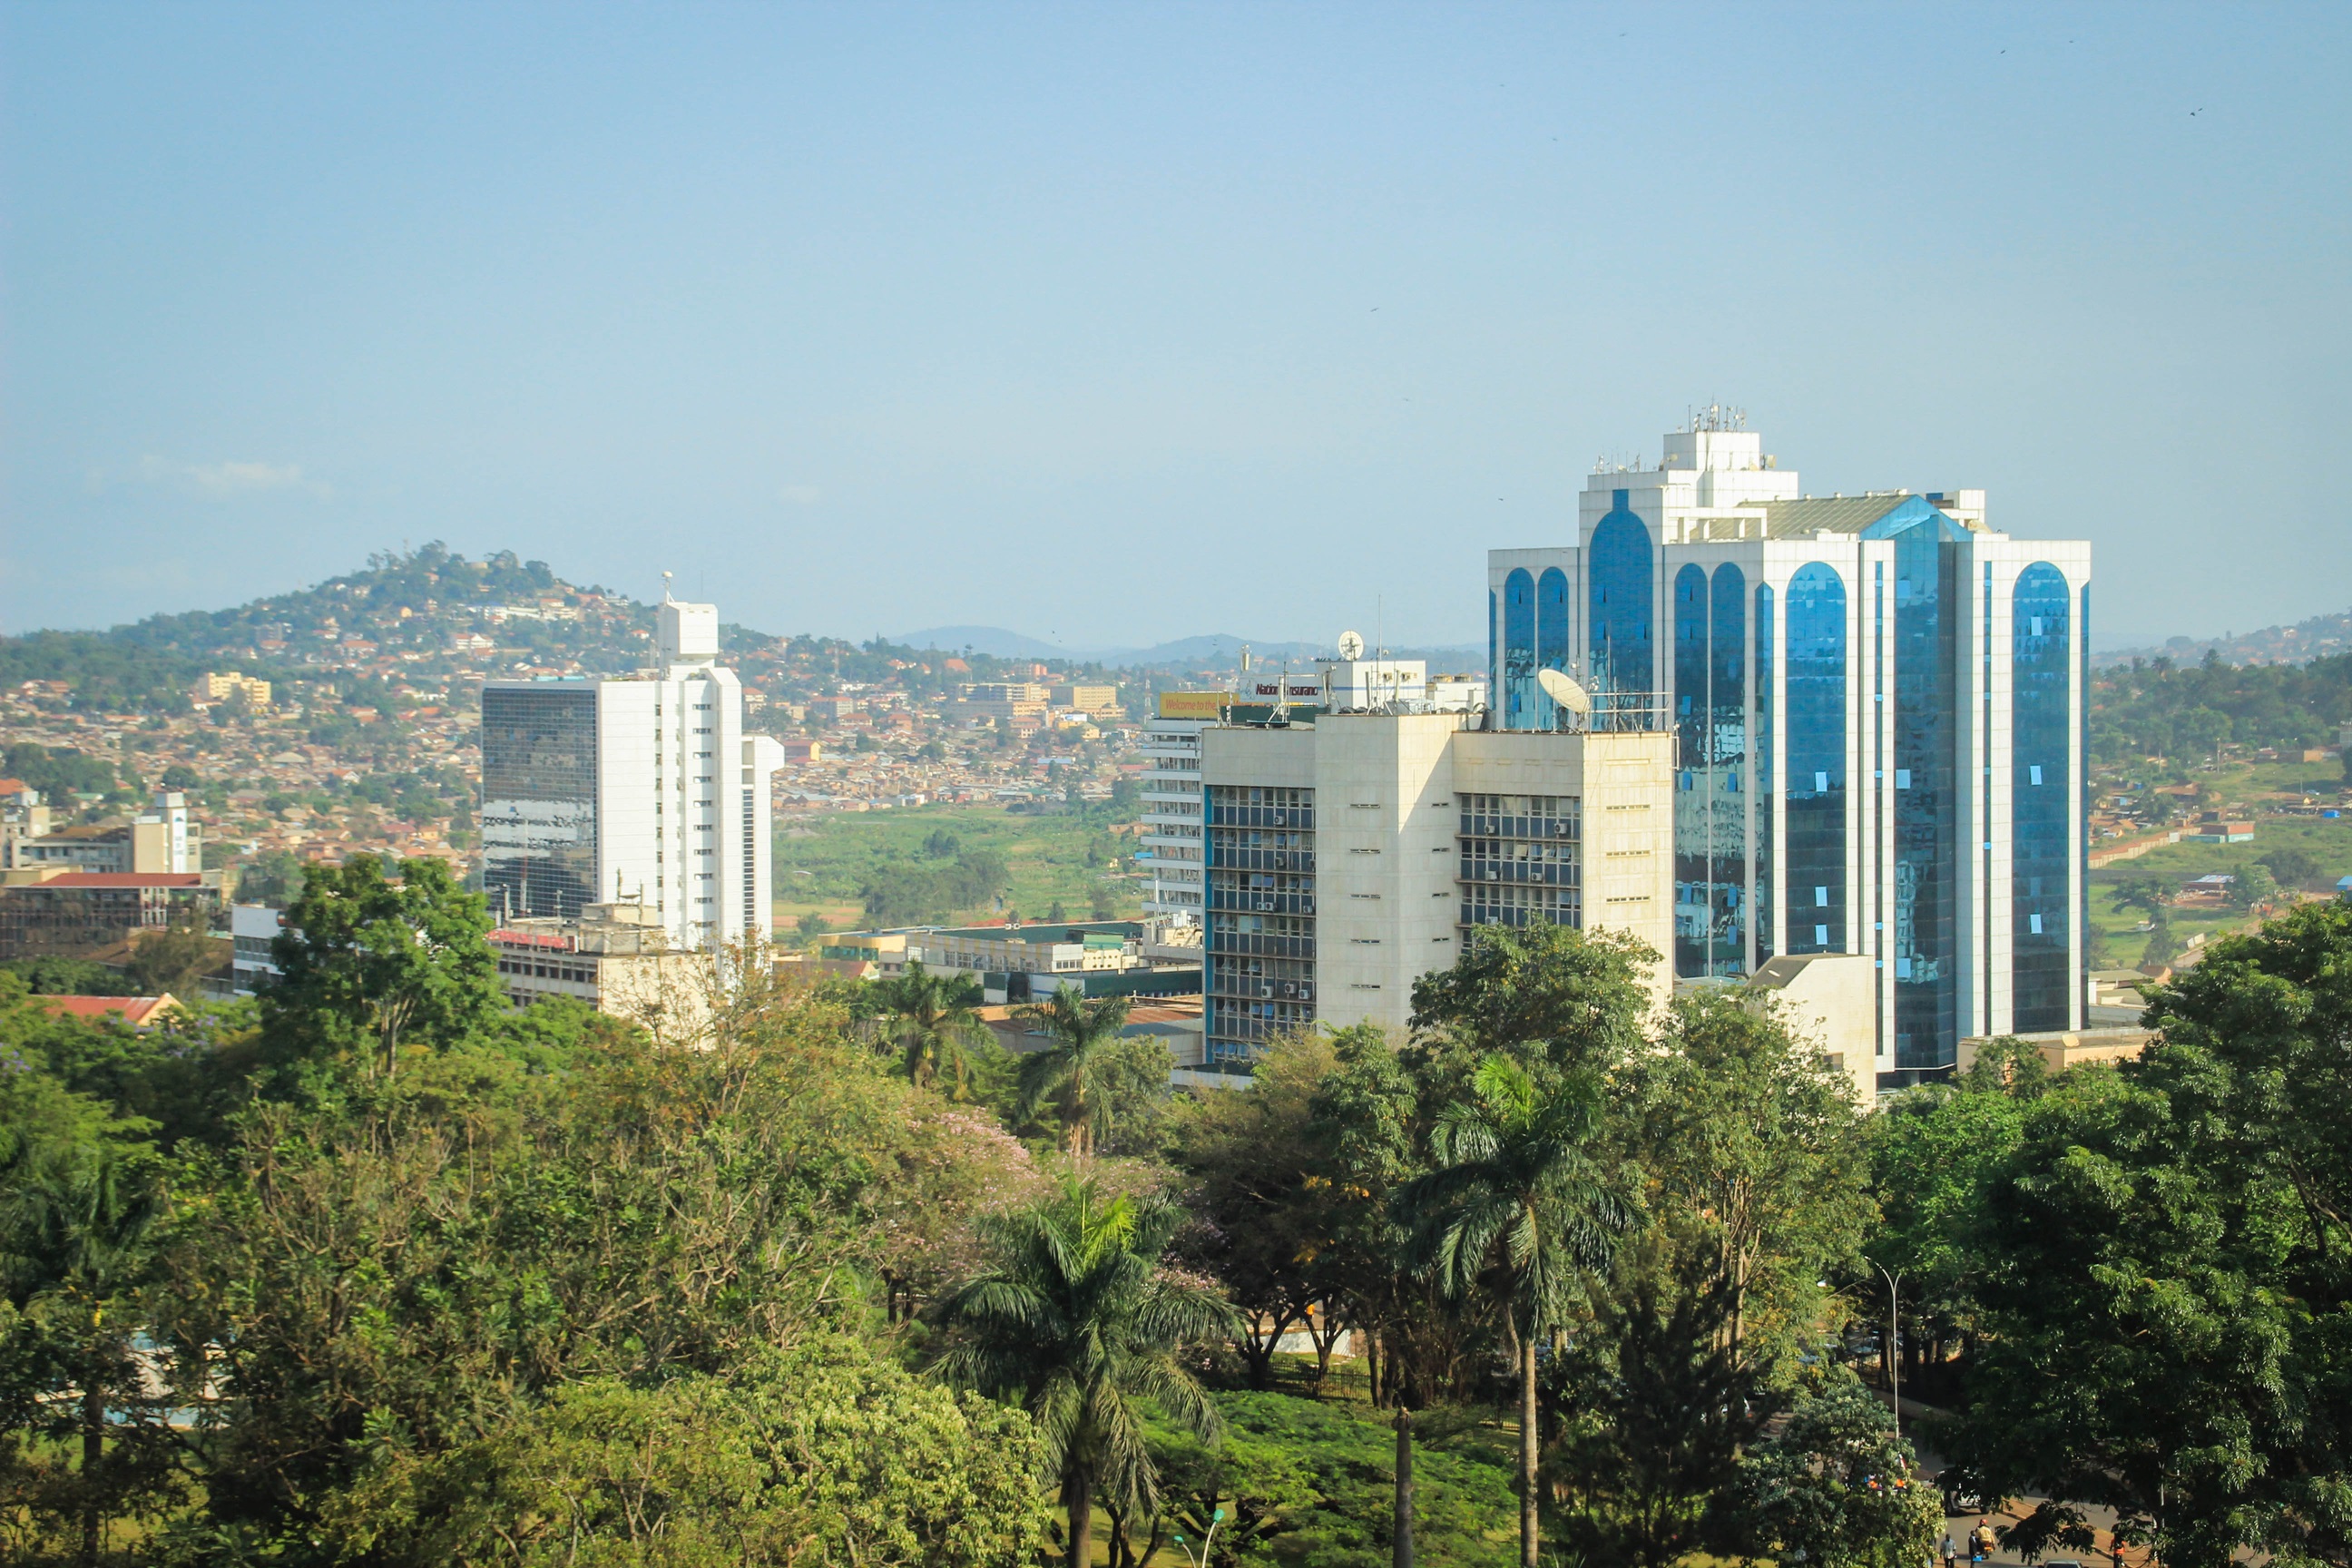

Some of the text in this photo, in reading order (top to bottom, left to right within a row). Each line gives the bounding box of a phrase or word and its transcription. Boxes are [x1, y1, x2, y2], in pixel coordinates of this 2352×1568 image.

[1256, 683, 1279, 695] Nation
[1165, 699, 1195, 710] Welcome
[1197, 701, 1204, 710] to
[1205, 699, 1216, 710] the
